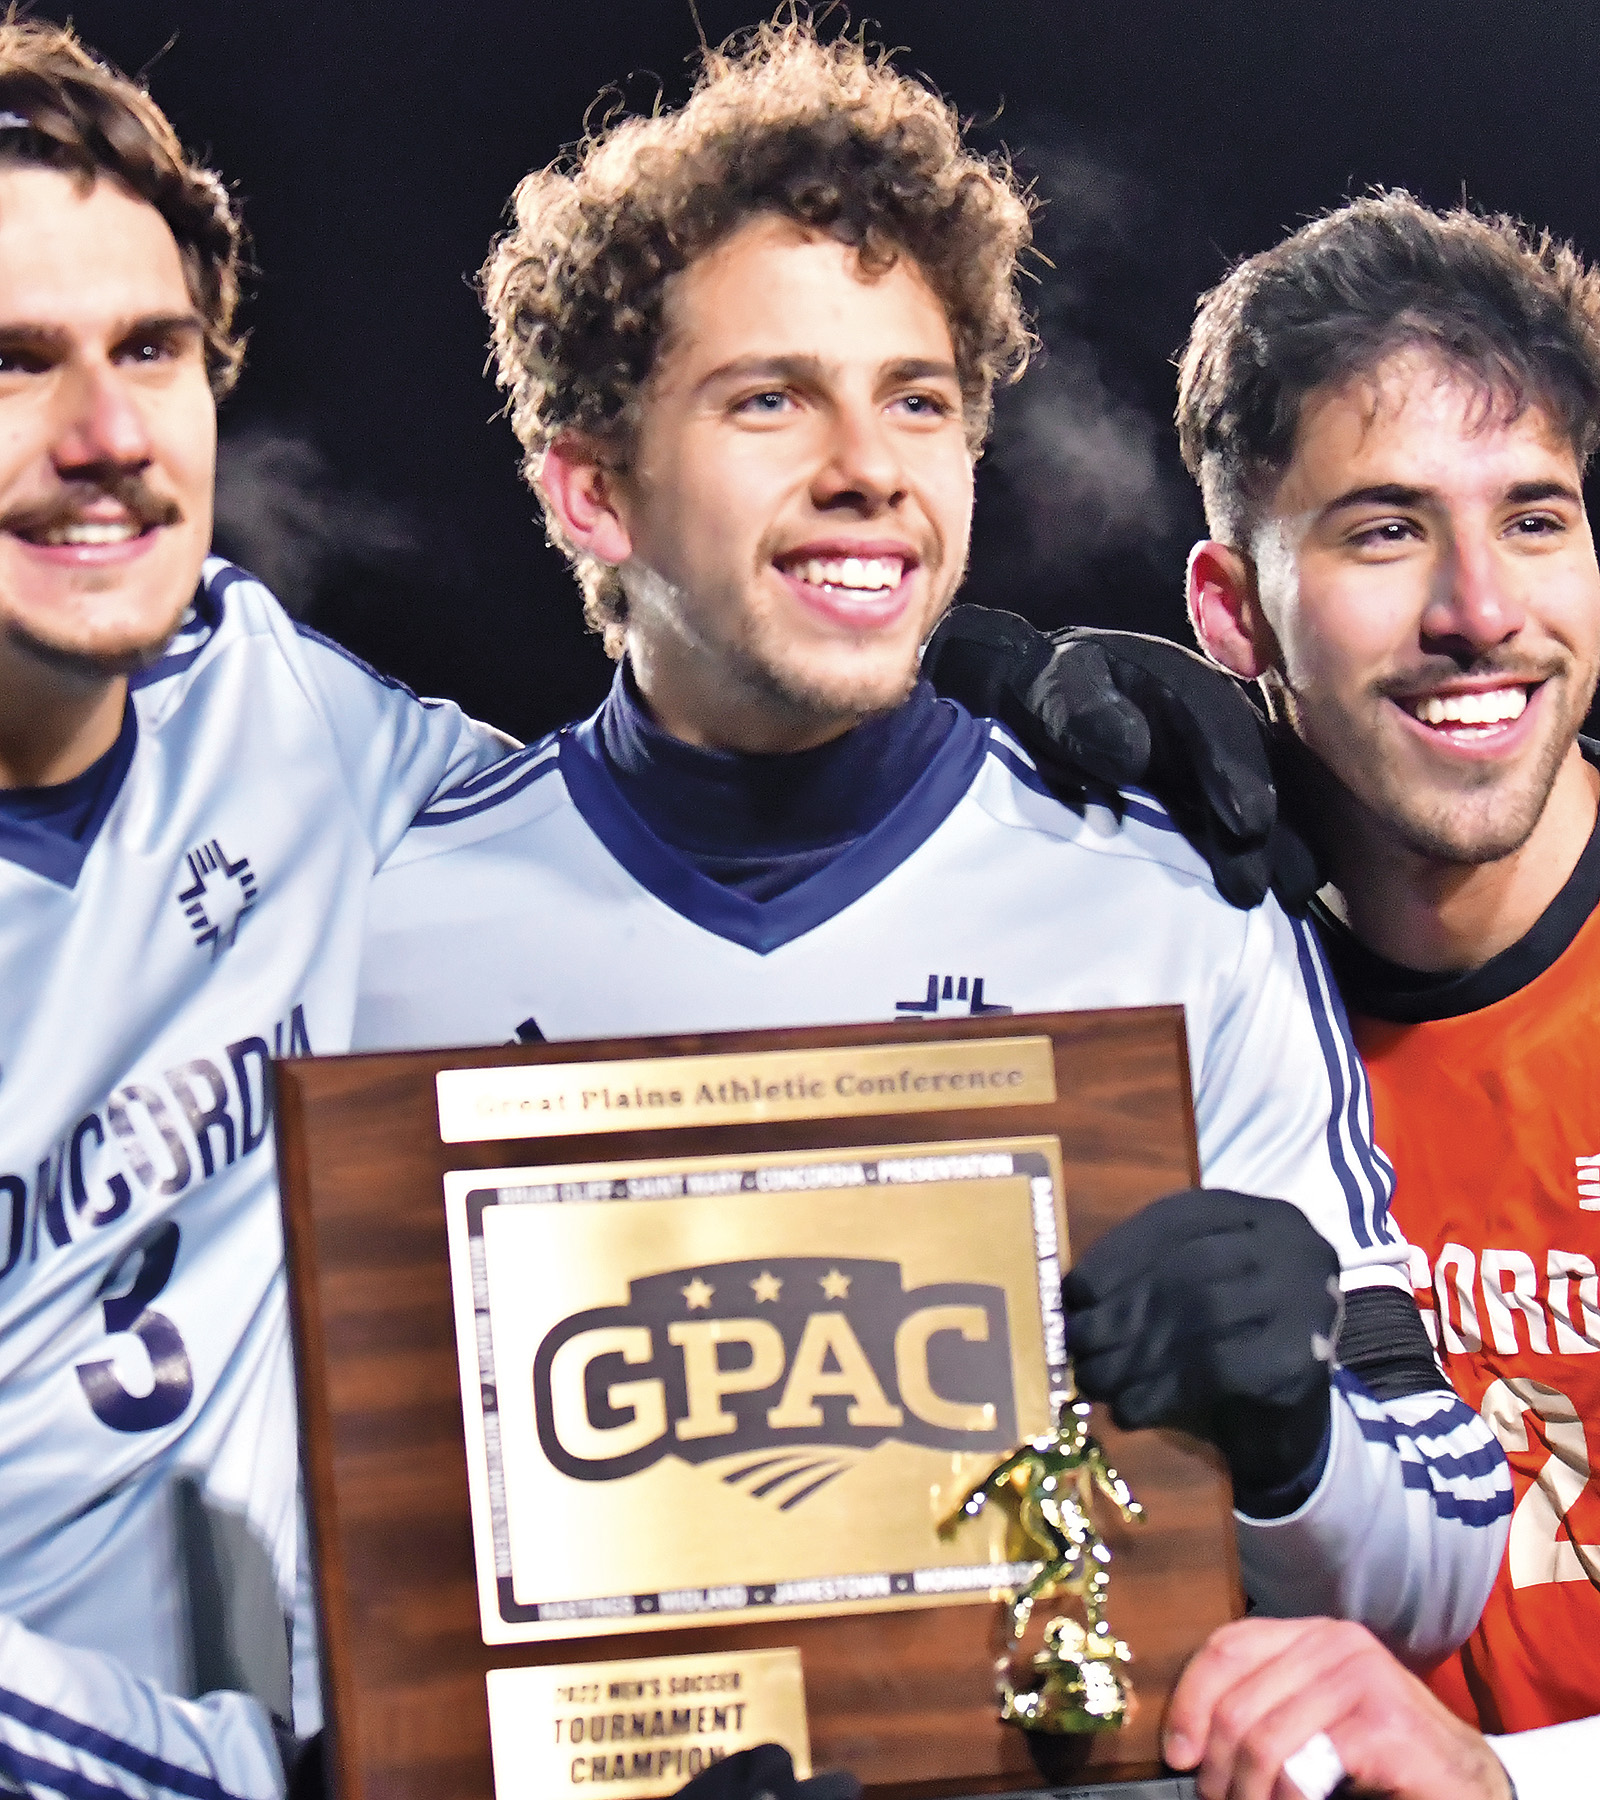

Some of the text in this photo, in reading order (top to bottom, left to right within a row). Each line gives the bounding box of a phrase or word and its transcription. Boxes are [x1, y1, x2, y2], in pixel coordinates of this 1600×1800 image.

[476, 1068, 1025, 1116] reat Plains Athletic Conference
[76, 1217, 193, 1433] 3
[549, 1303, 998, 1461] GPAC
[554, 1702, 746, 1745] TOURNAMENT
